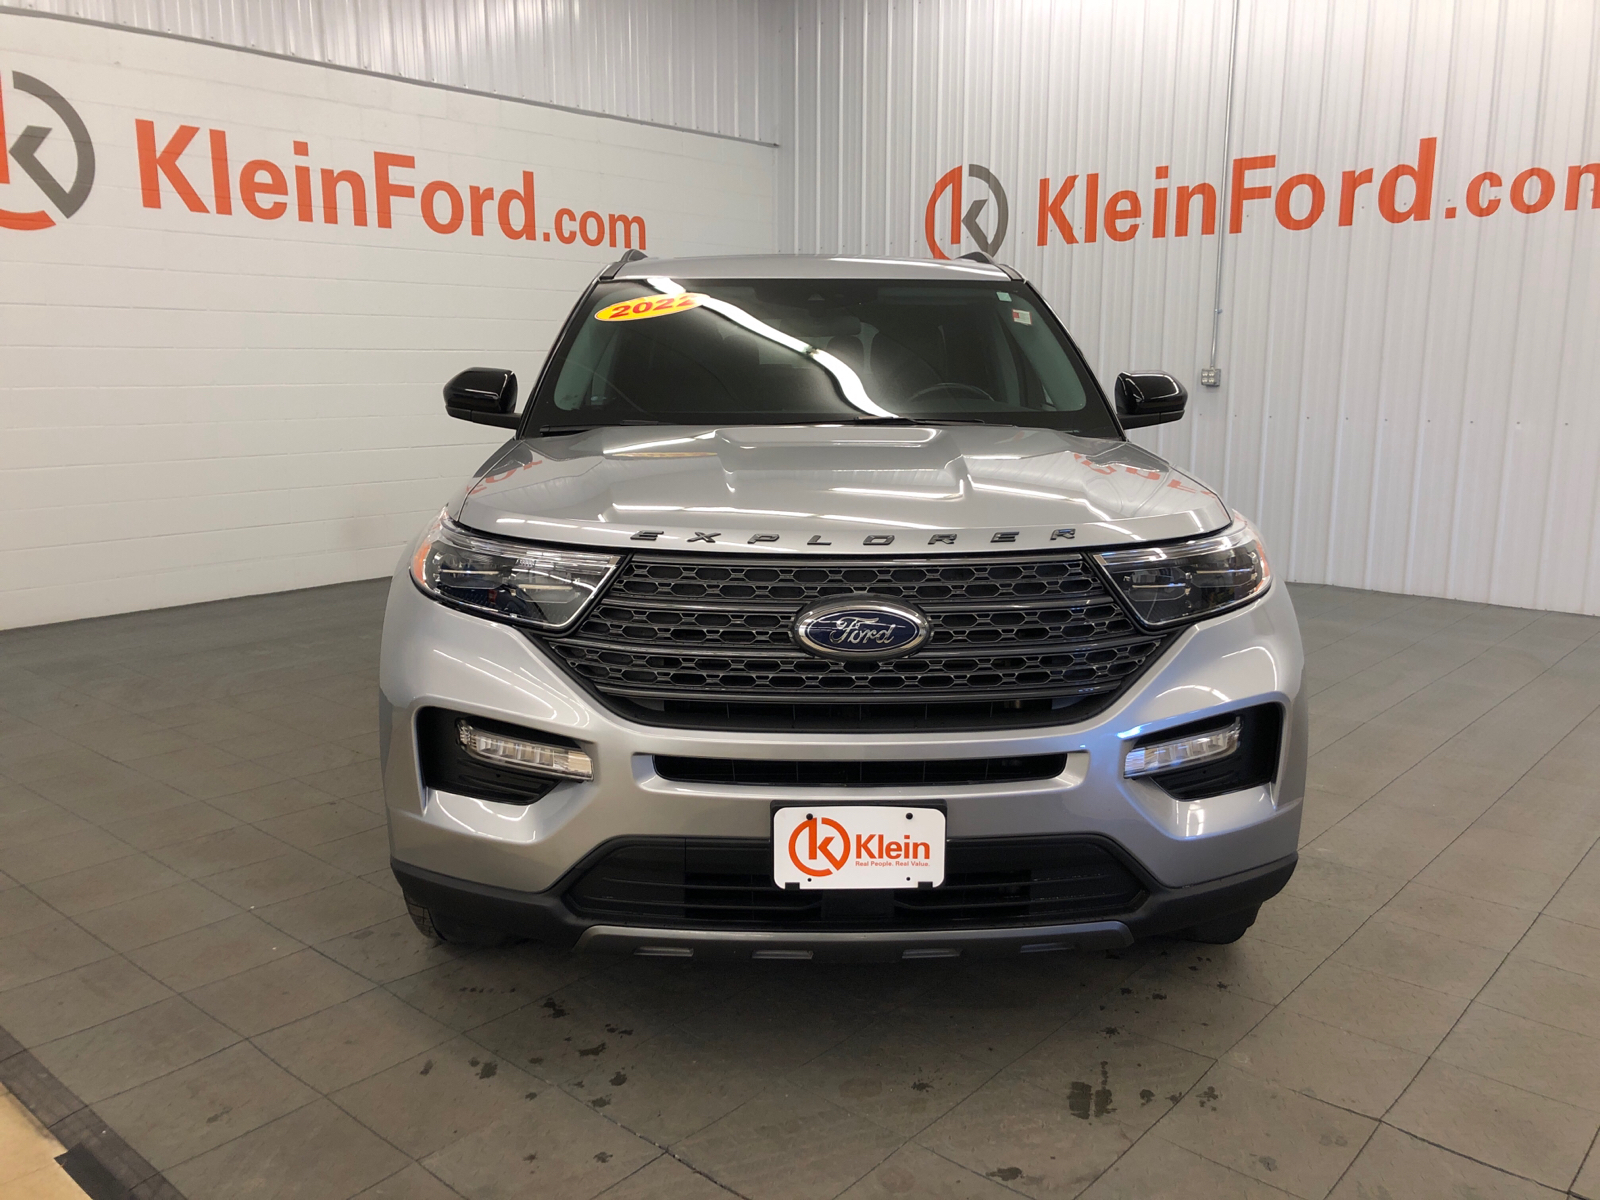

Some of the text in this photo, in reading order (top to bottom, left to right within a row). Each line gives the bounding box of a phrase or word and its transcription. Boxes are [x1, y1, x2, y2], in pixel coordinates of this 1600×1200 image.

[134, 118, 647, 250] KleinFord.com
[608, 294, 698, 319] 2022
[629, 528, 1077, 546] EXPLORER
[828, 616, 900, 645] Ford
[855, 834, 930, 860] Klein
[870, 860, 894, 868] People.
